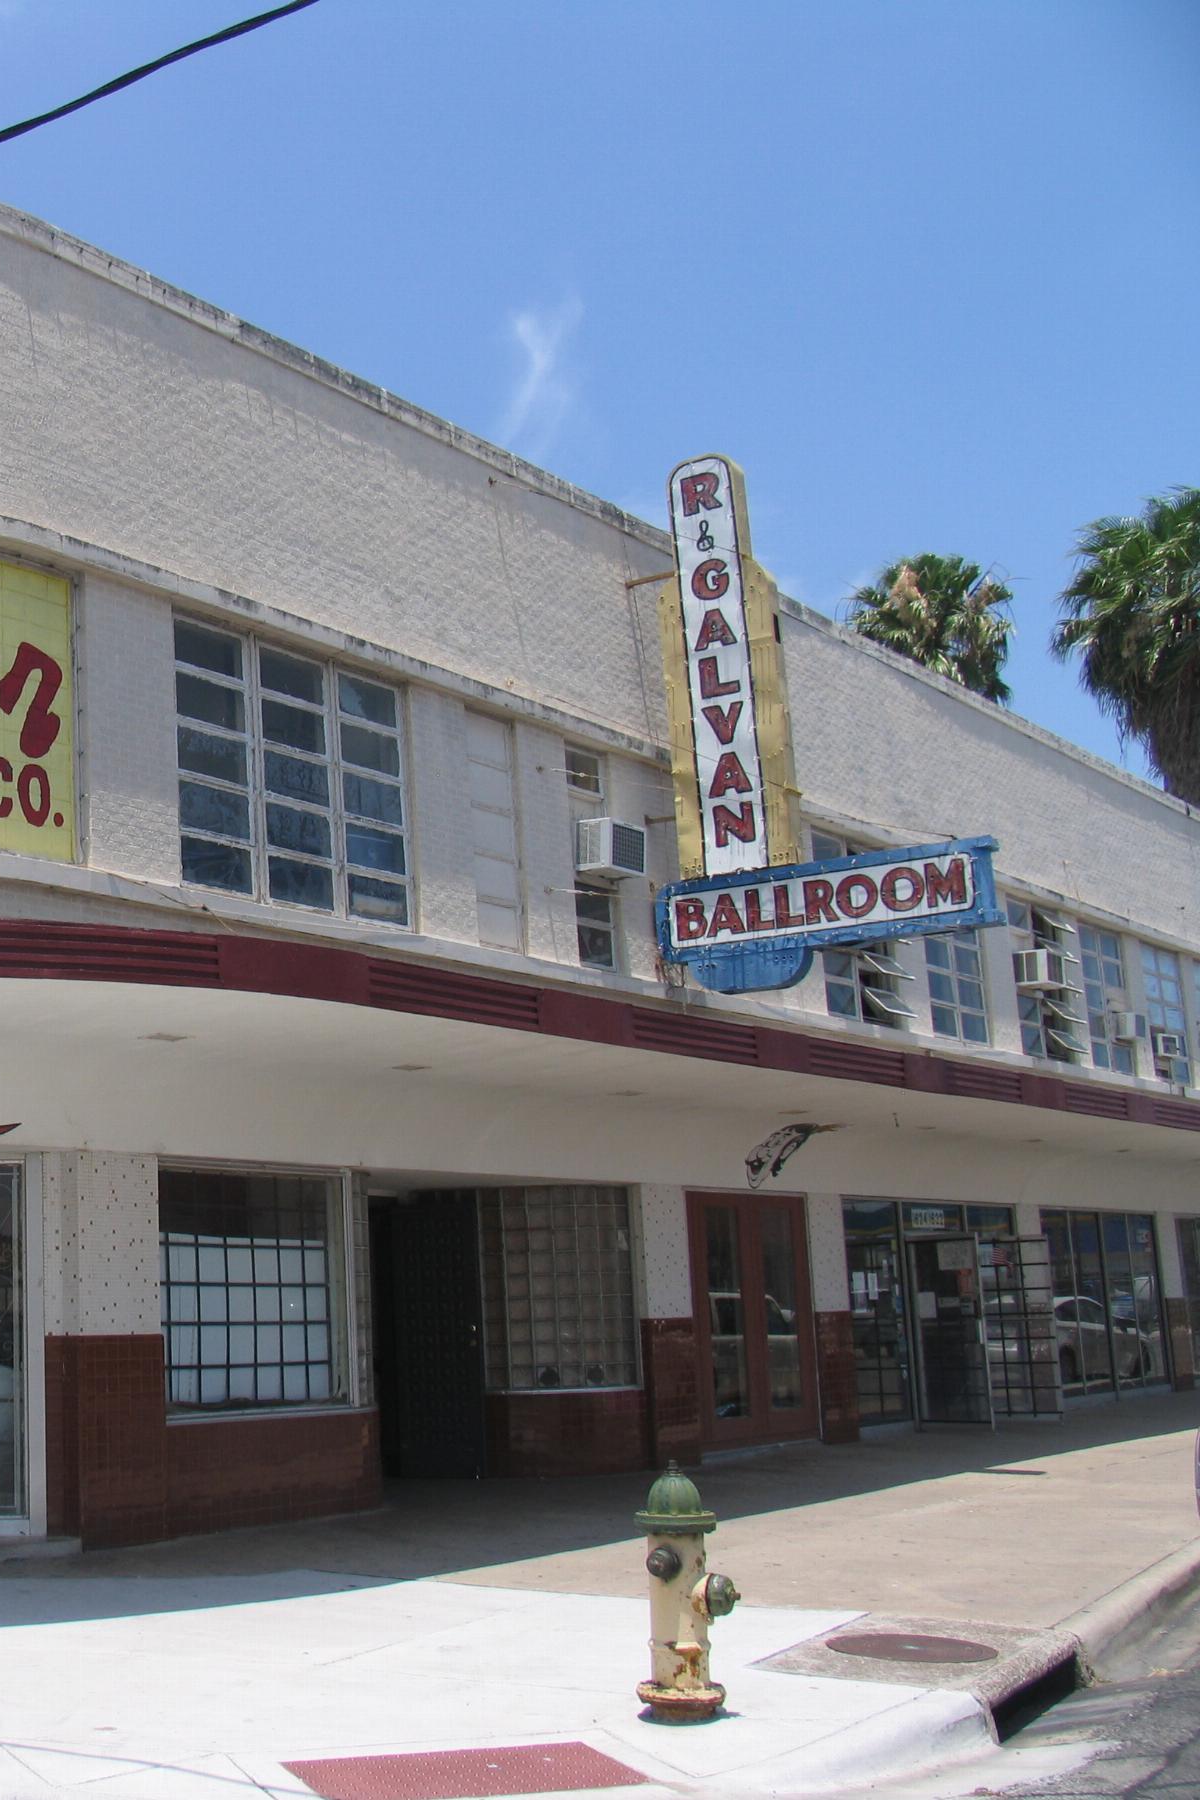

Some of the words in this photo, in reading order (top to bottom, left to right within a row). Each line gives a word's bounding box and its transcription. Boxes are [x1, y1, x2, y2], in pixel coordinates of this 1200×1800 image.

[680, 472, 723, 517] R
[691, 558, 755, 848] GALVAN
[675, 857, 968, 943] BALLROOM
